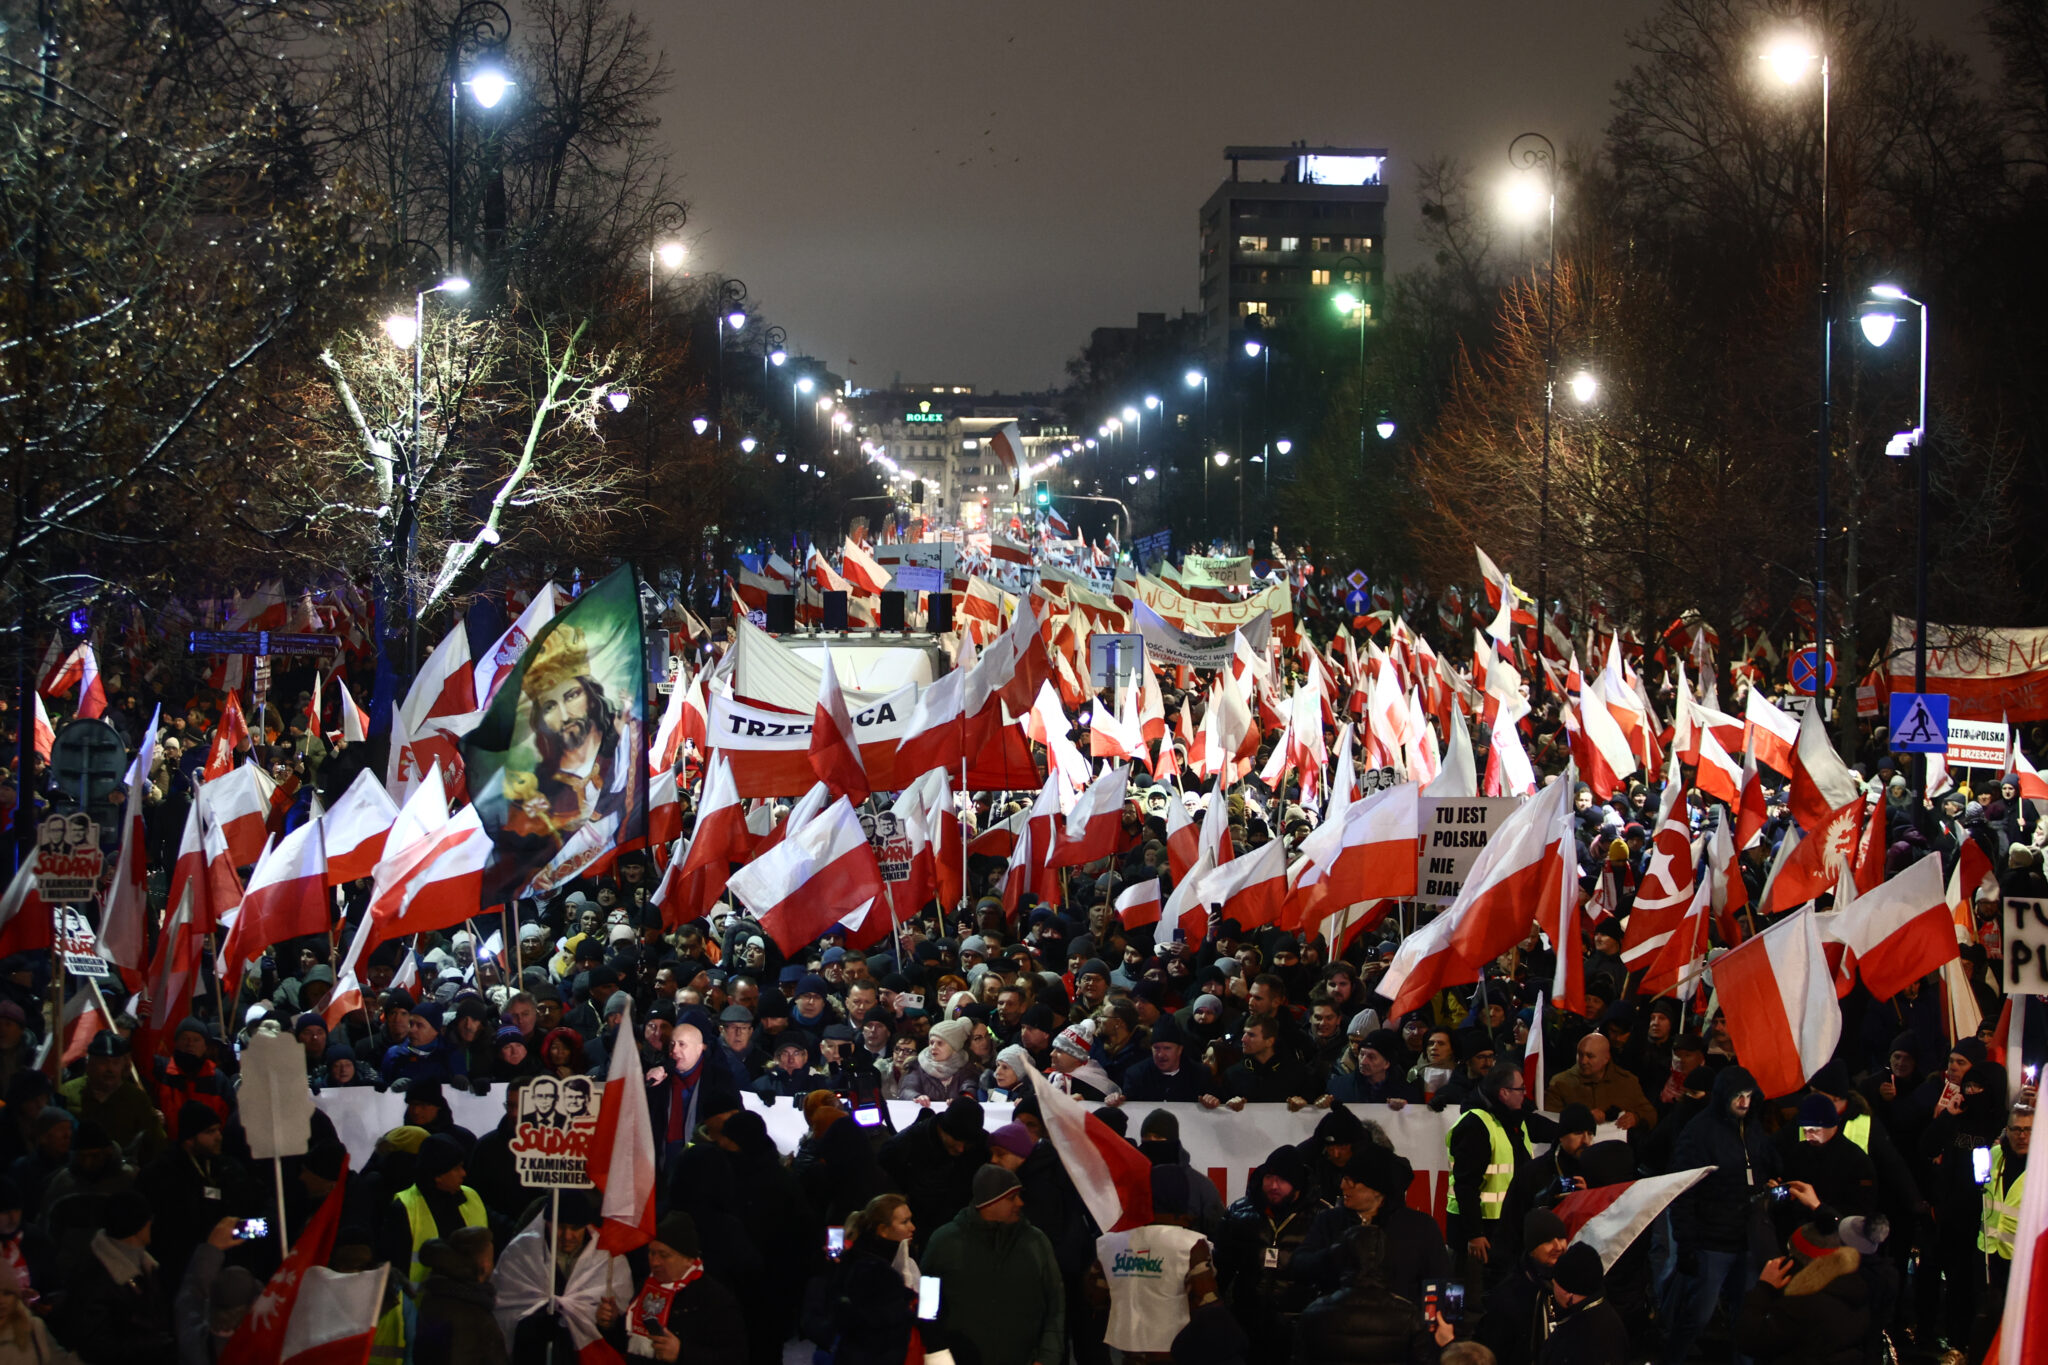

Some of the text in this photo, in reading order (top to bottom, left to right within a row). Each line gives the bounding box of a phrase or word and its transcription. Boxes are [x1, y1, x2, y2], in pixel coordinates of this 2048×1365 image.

[906, 413, 943, 422] ROLEX
[1976, 731, 2005, 742] POLSKA
[1961, 748, 2004, 761] BRZESZCZE
[1436, 807, 1488, 824] TU JEST
[1433, 831, 1487, 847] POLSKA
[1430, 858, 1454, 874] NIE
[520, 1158, 527, 1169] Z
[532, 1170, 591, 1185] WĄSIKIEM
